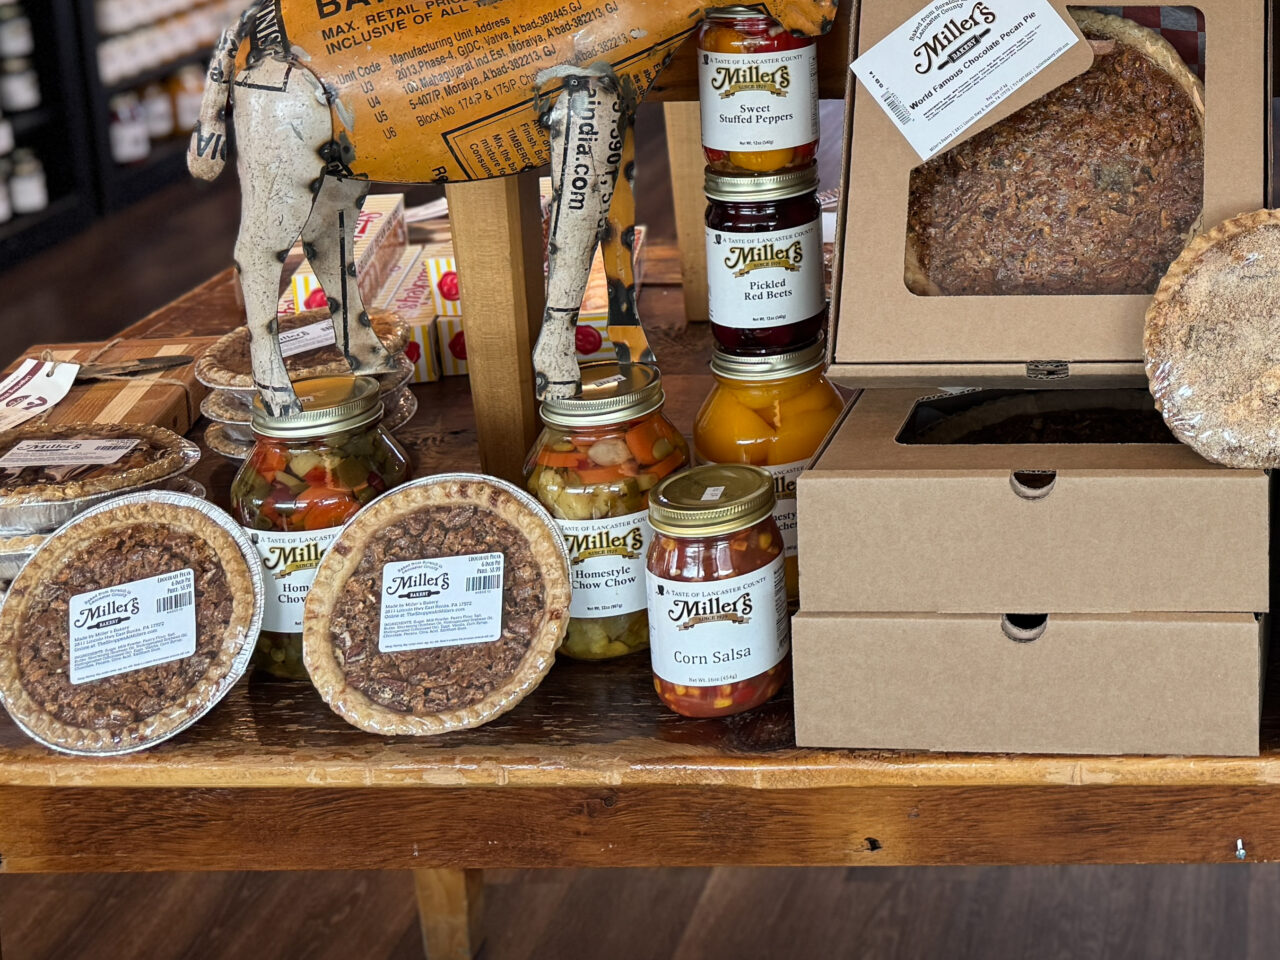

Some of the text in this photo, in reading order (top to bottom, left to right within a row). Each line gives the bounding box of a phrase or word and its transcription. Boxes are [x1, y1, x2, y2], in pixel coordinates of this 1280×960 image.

[322, 20, 360, 41] MAX.
[365, 4, 420, 26] RETAIL
[916, 3, 964, 40] Lancaster County
[921, 10, 935, 22] from
[325, 4, 470, 55] INCLUSIVE OF ALL
[389, 16, 511, 66] Manufacturing Unit Address
[914, 2, 996, 74] Miller's
[360, 81, 375, 94] U3
[604, 1, 618, 14] GJ
[909, 10, 1037, 111] World Famous Chocolate Pecan Pie
[952, 38, 977, 58] BAKERY
[337, 61, 382, 85] Unit Code
[367, 96, 381, 109] U4
[542, 44, 557, 57] GJ
[711, 65, 790, 90] Miller's
[374, 110, 389, 124] U5
[416, 110, 442, 127] Block
[484, 89, 493, 101] &
[719, 113, 794, 124] Stuffed Peppers
[740, 104, 770, 113] Sweet
[383, 126, 397, 140] U6
[480, 138, 500, 168] mixture
[492, 133, 512, 163] Mix the
[724, 241, 803, 269] Miller's
[744, 290, 793, 301] Red Beets
[750, 279, 786, 290] Pickled
[563, 527, 643, 553] Miller's
[386, 572, 450, 595] Miller's
[572, 576, 637, 590] Chow Chow
[575, 566, 631, 579] Homestyle
[672, 589, 690, 598] TASTE
[702, 586, 741, 598] LANCASTER
[743, 576, 766, 590] COUNTY
[74, 597, 140, 628] Miller's
[668, 592, 753, 621] Miller's
[674, 646, 752, 665] Corn Salsa
